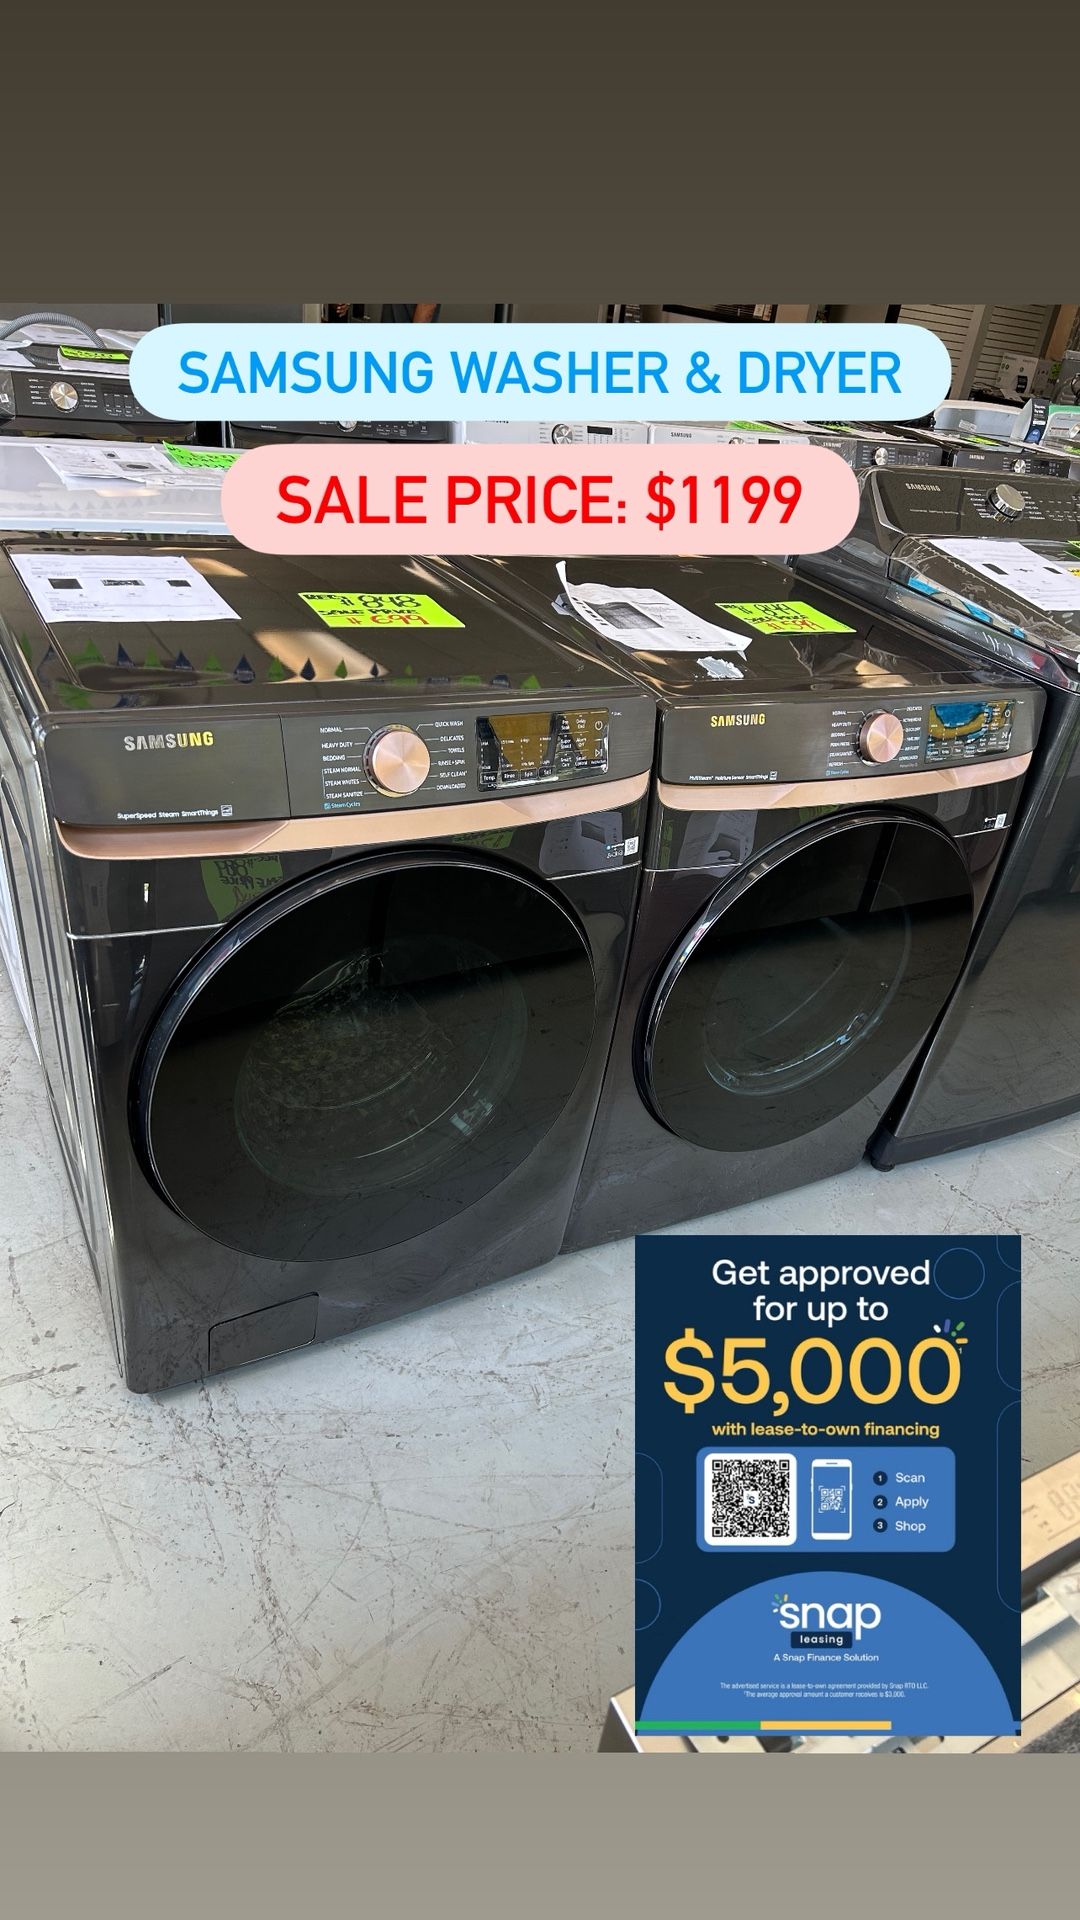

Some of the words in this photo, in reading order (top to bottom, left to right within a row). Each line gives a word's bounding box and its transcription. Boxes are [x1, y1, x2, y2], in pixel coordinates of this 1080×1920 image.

[905, 482, 941, 492] SAMSUNG
[710, 713, 766, 727] SAMSUNG
[124, 731, 214, 751] SAMSUNG
[322, 754, 346, 762] BEDDING
[117, 812, 157, 820] SuperSpeed
[181, 808, 218, 817] SmartThings
